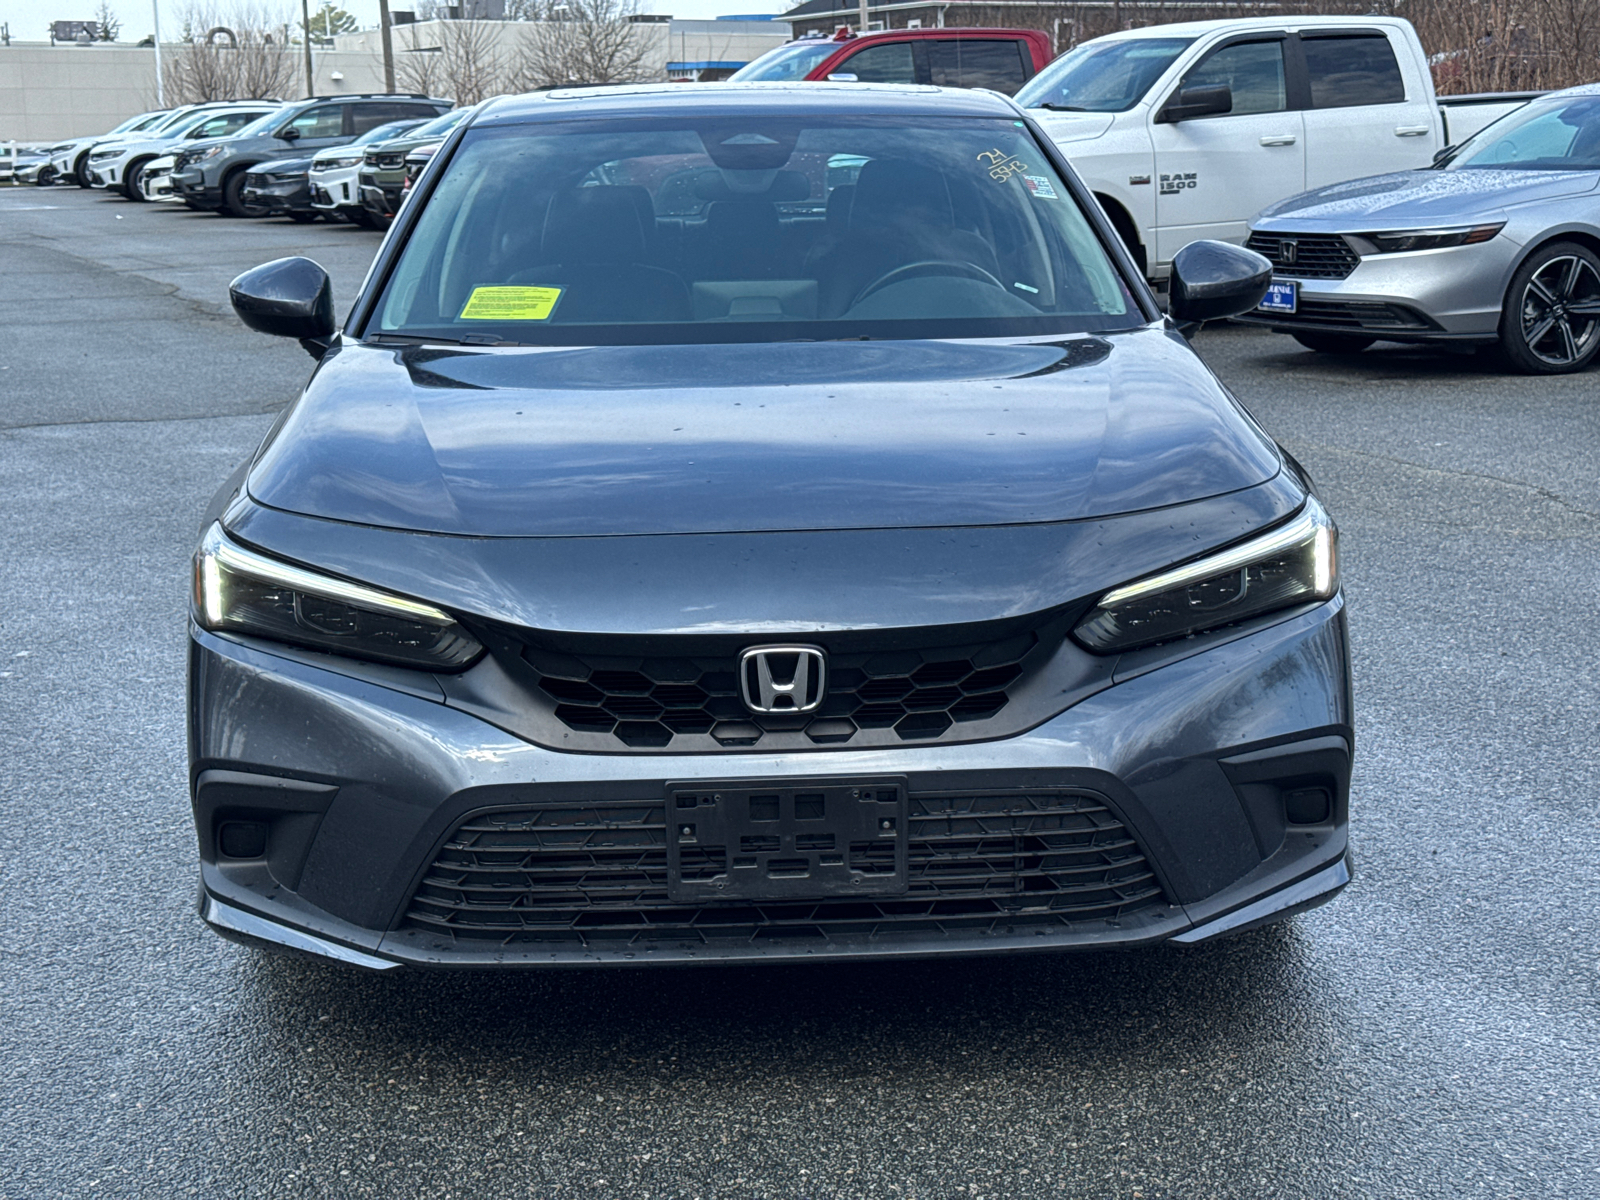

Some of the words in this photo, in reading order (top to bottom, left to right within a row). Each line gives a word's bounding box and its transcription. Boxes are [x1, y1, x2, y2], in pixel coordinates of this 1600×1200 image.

[976, 148, 1007, 164] 24
[1160, 173, 1197, 181] RAM
[1160, 181, 1197, 190] 1500
